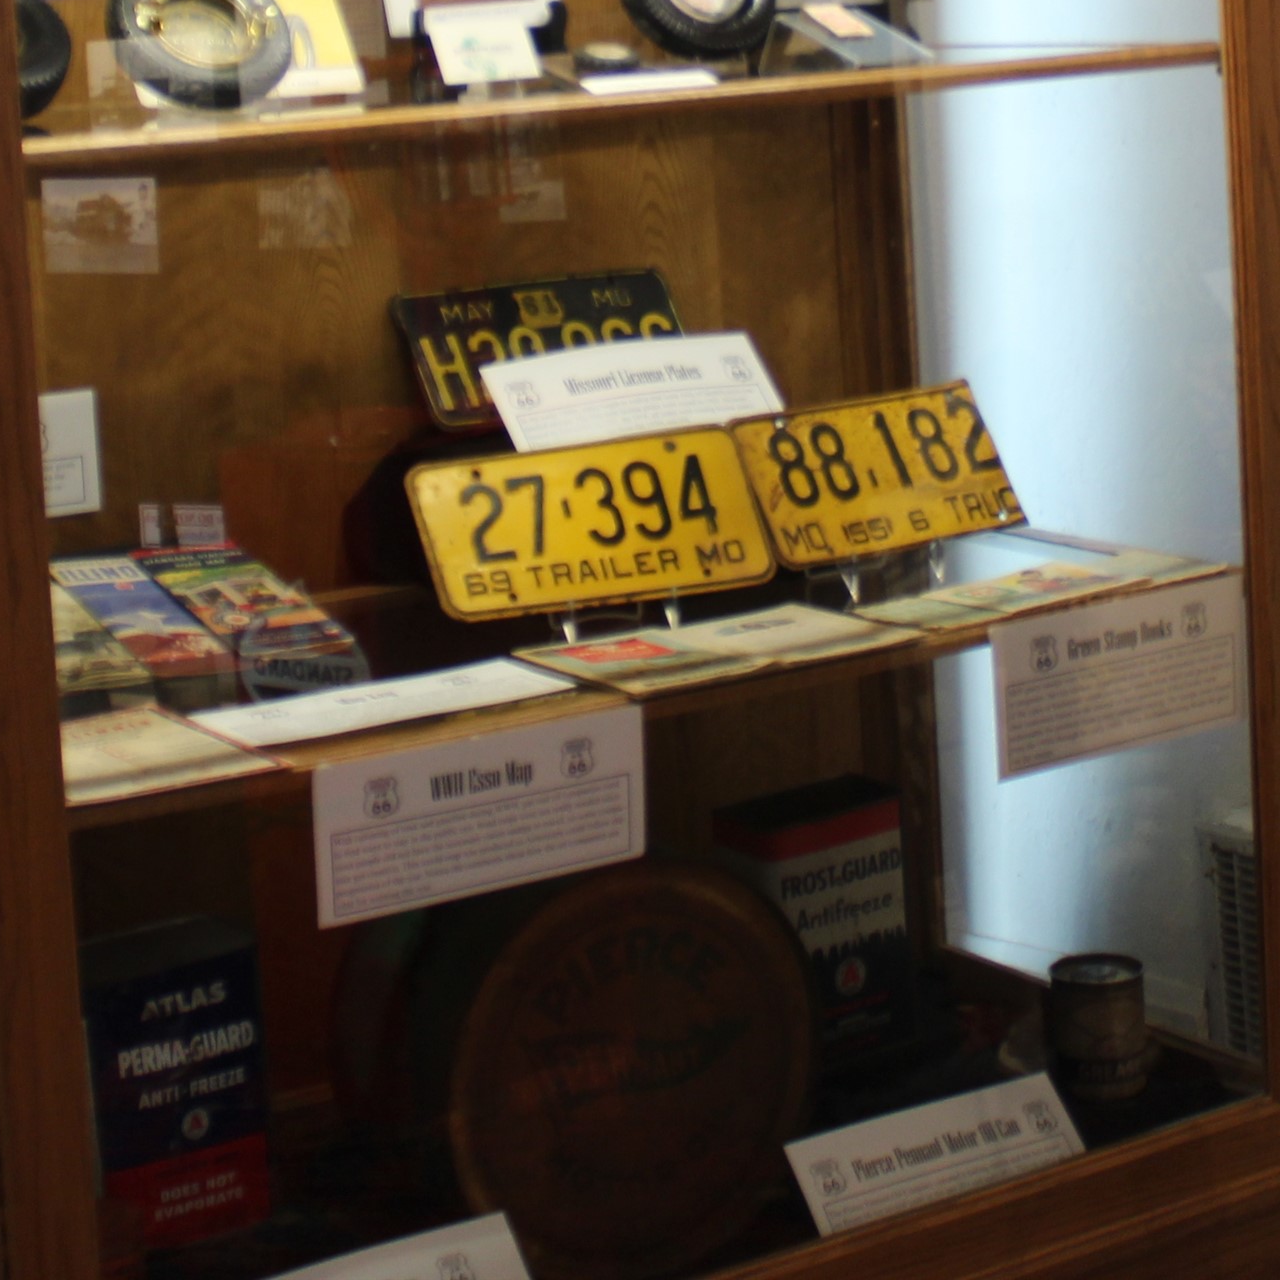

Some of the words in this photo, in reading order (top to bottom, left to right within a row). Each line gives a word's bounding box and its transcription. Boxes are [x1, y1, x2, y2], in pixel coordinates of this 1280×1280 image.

[439, 300, 495, 326] MAY
[562, 373, 618, 397] Missouri
[463, 570, 513, 598] 69
[526, 549, 681, 589] TRAILER
[695, 539, 747, 573] MO
[1067, 636, 1101, 661] Green
[1104, 626, 1138, 652] Stamp
[505, 760, 533, 787] Map
[797, 891, 894, 933] Antifreeze
[139, 979, 228, 1023] ATLAS
[116, 1019, 256, 1080] PERMA-GUARD
[851, 1154, 897, 1183] Pierce
[893, 1136, 944, 1169] Pennant
[153, 1185, 246, 1223] EVAPORATE
[159, 1180, 201, 1203] DOES
[206, 1171, 236, 1189] NOT
